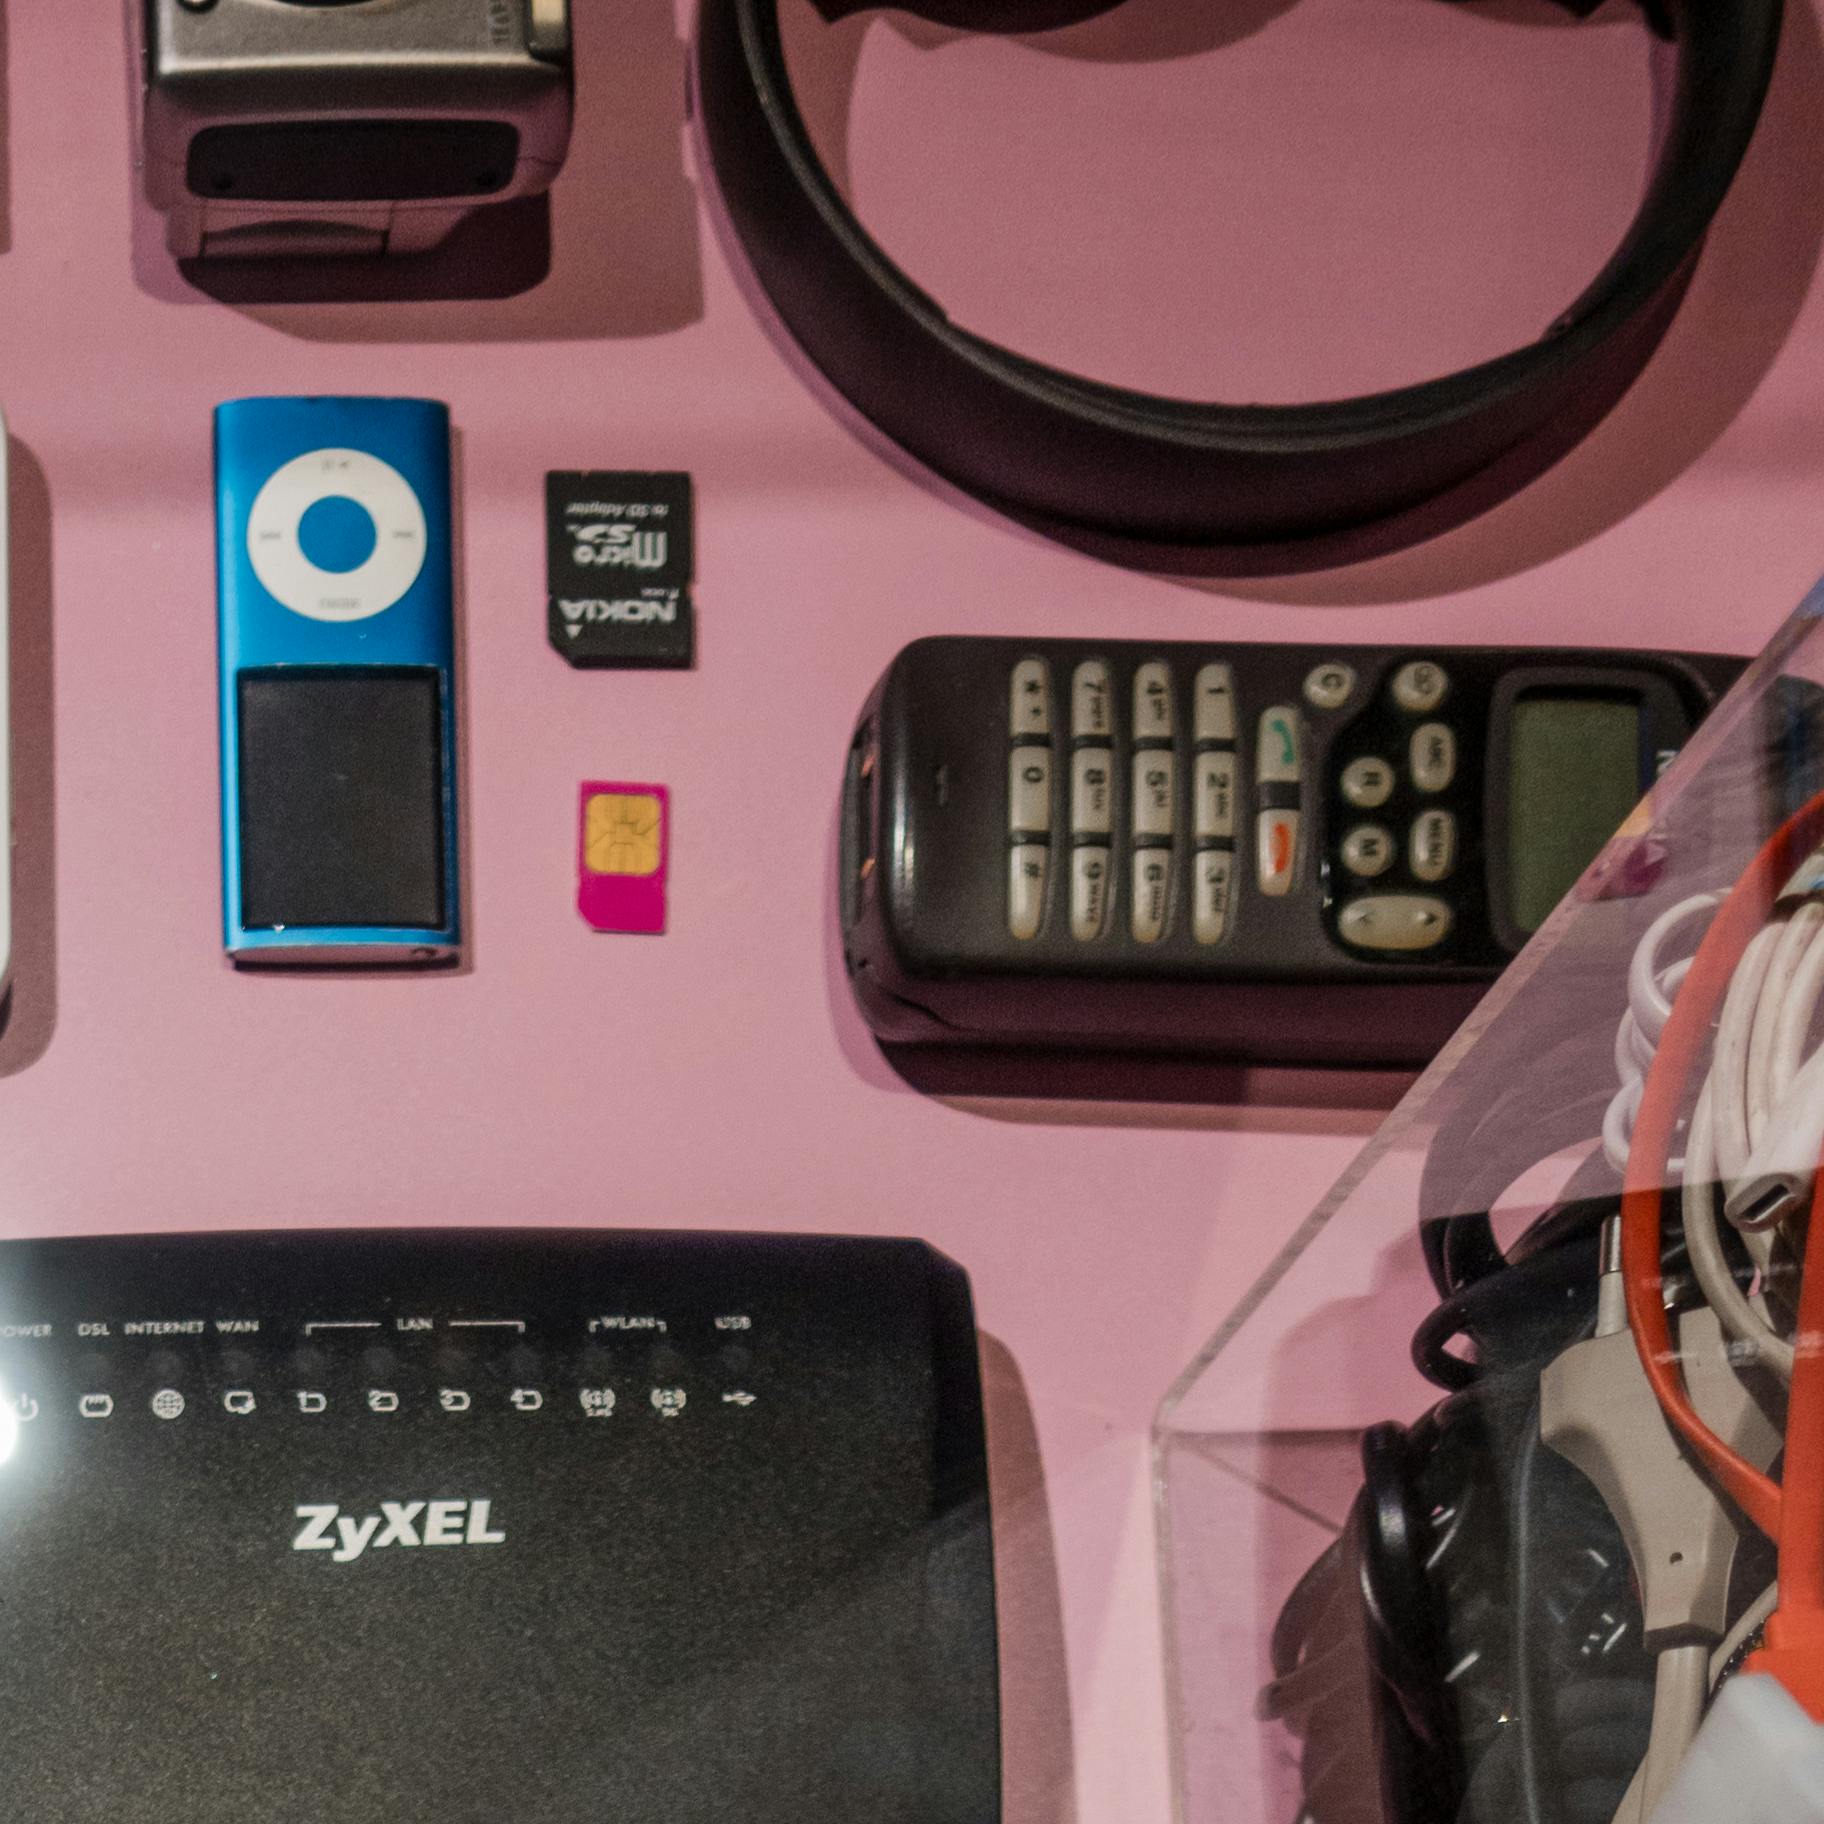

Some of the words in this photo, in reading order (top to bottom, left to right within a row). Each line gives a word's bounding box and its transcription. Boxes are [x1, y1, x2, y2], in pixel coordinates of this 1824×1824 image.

[559, 599, 678, 624] NOKIA
[1084, 679, 1106, 695] 7
[1146, 680, 1166, 696] 4
[1207, 685, 1228, 696] 1
[1084, 768, 1106, 785] 8
[1147, 770, 1169, 787] 5
[1207, 772, 1230, 789] 2
[1361, 838, 1378, 856] M
[1430, 818, 1444, 867] MENU
[1085, 862, 1105, 880] 9
[1145, 863, 1165, 882] 6
[1205, 867, 1227, 885] 3
[77, 1322, 111, 1337] DSL
[124, 1319, 206, 1335] INTERNET
[215, 1319, 260, 1334] WAN
[396, 1316, 435, 1331] LAN
[601, 1315, 657, 1330] WLAN
[714, 1315, 753, 1330] USB
[292, 1498, 506, 1563] ZyXEL
